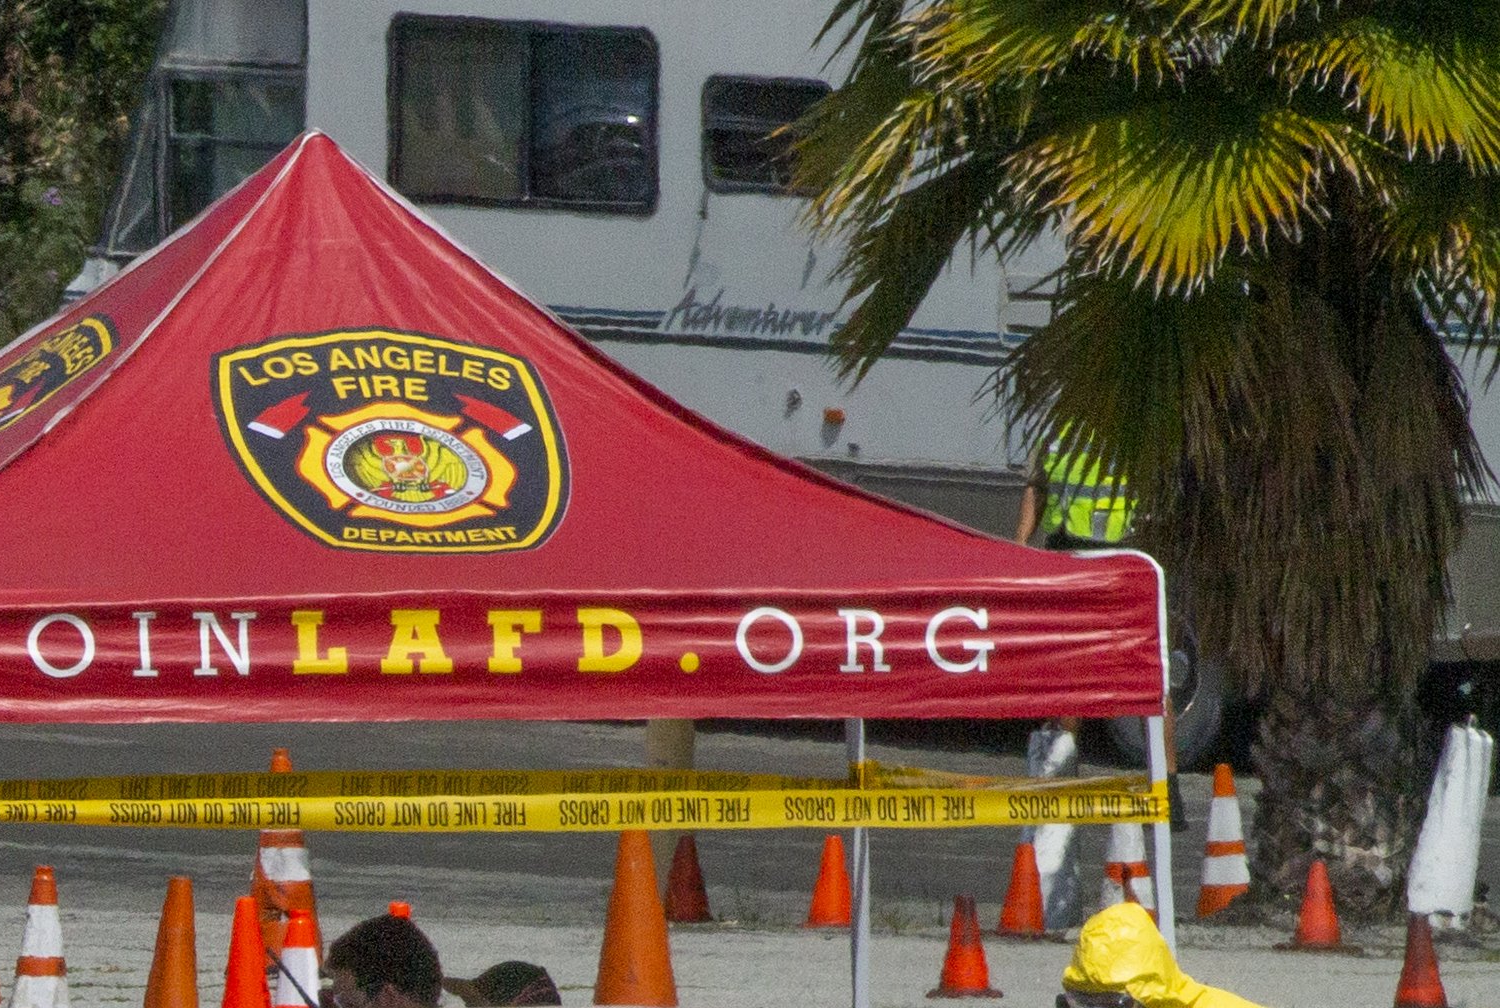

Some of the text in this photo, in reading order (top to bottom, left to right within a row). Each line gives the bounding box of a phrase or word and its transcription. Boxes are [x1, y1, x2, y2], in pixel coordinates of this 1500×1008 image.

[239, 345, 512, 391] LOS ANGELES
[331, 375, 429, 401] FIRE
[380, 419, 416, 431] FIRE
[364, 494, 438, 512] FOUNDED
[342, 526, 517, 544] DEPARTMENT
[5, 803, 37, 821] LINE
[46, 803, 77, 821] FIRE
[109, 802, 301, 825] FIRE LINE DO NOT CROSS
[334, 801, 526, 827] FIRE LINE DO NOT CROSS
[559, 797, 750, 826] FIRE LINE DO NOT CROSS
[784, 795, 976, 822] FIRE LINE DO NOT CROSS
[1007, 794, 1160, 820] LINE DO NOT CROSS
